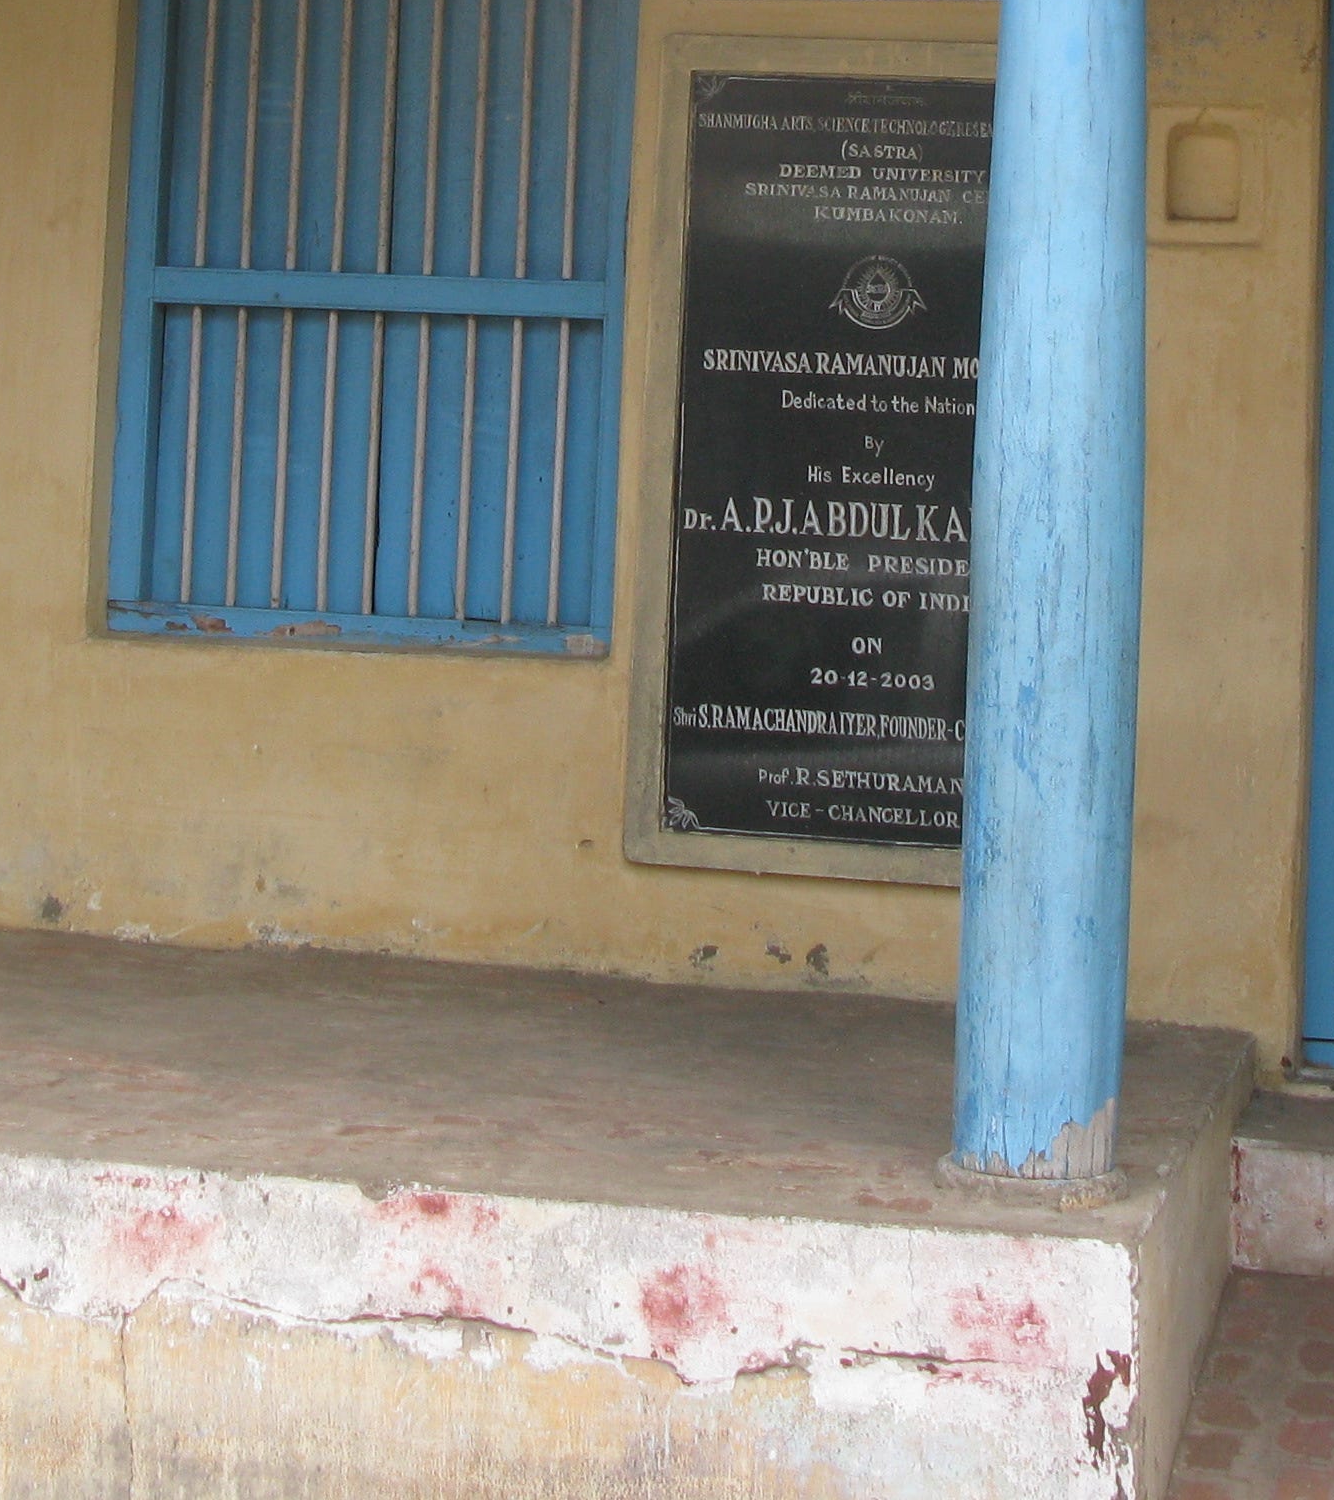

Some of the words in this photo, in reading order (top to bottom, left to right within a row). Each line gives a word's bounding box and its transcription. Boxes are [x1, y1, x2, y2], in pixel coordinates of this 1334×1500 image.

[698, 113, 778, 130] SHANMUGHA
[841, 139, 924, 163] (SASTRA)
[779, 164, 862, 179] DEEMED
[871, 167, 987, 184] UNIVERSITY
[745, 182, 842, 199] SRINIVASA
[847, 185, 952, 203] RAMANUJAN
[703, 349, 813, 374] SRINIVASA
[814, 351, 947, 378] RAMANUJAN
[782, 389, 867, 411] Dedicated
[871, 395, 888, 412] to
[891, 394, 919, 413] the
[924, 396, 975, 416] Nation
[865, 436, 885, 457] By
[807, 465, 832, 483] His
[842, 466, 936, 491] Excellency
[762, 583, 874, 607] REPUBLIC
[882, 590, 911, 608] OF
[851, 637, 883, 654] ON
[810, 668, 935, 690] 20-12-2003
[673, 706, 697, 727] Shri
[766, 800, 811, 818] VICE
